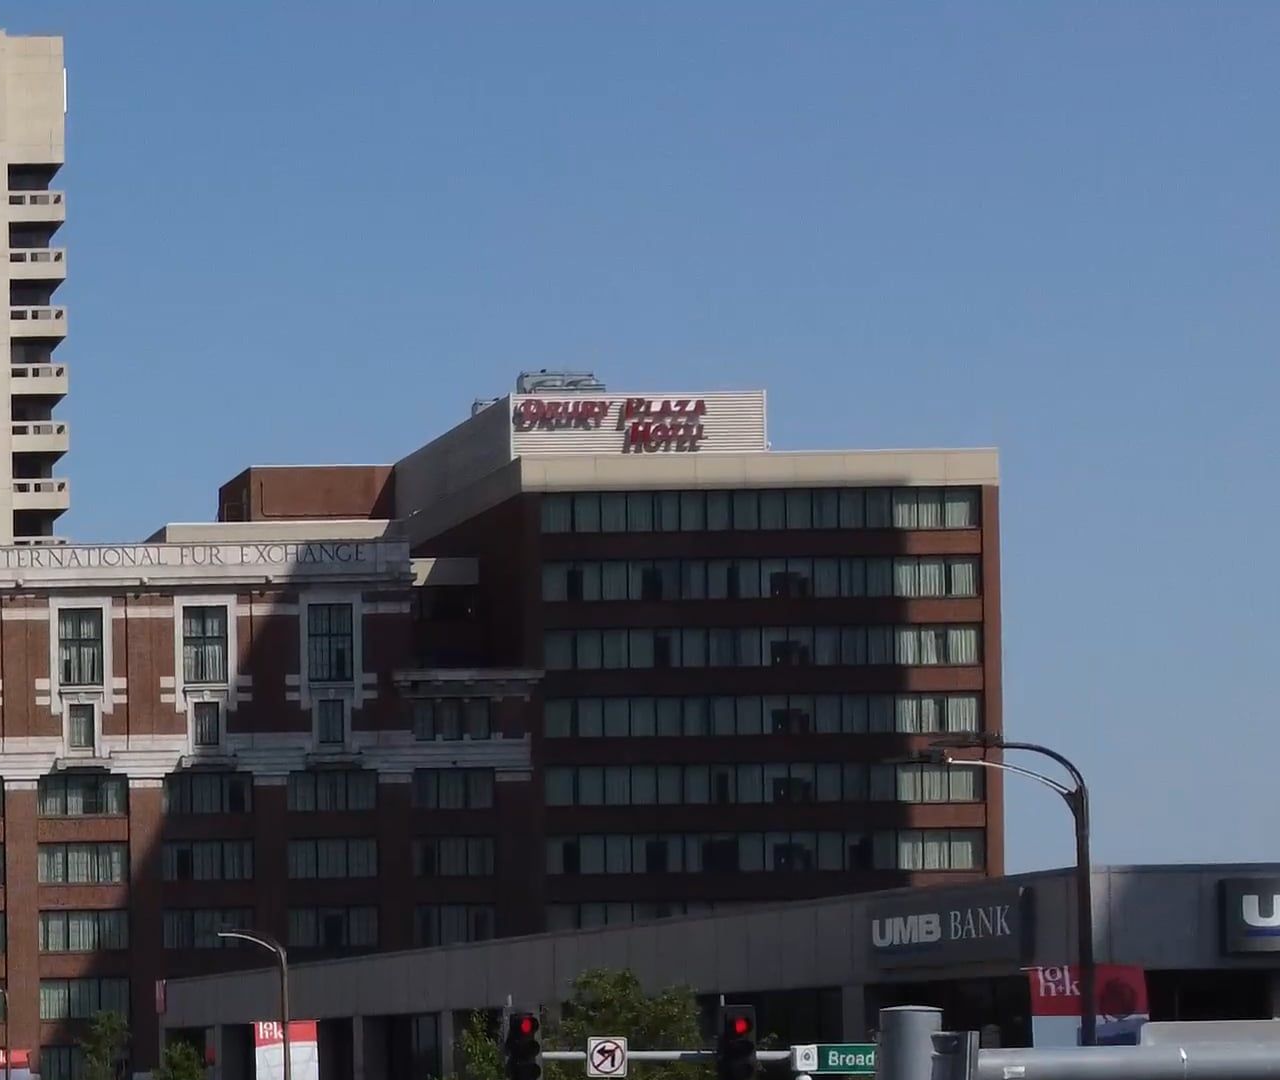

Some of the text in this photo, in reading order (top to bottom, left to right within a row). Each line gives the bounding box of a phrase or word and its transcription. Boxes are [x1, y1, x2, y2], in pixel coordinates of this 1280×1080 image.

[629, 422, 708, 445] HOTEL
[180, 546, 224, 566] FUR
[240, 544, 367, 565] EXCHANGE
[872, 905, 1012, 948] UMB BANK
[828, 1051, 878, 1066] Broad
